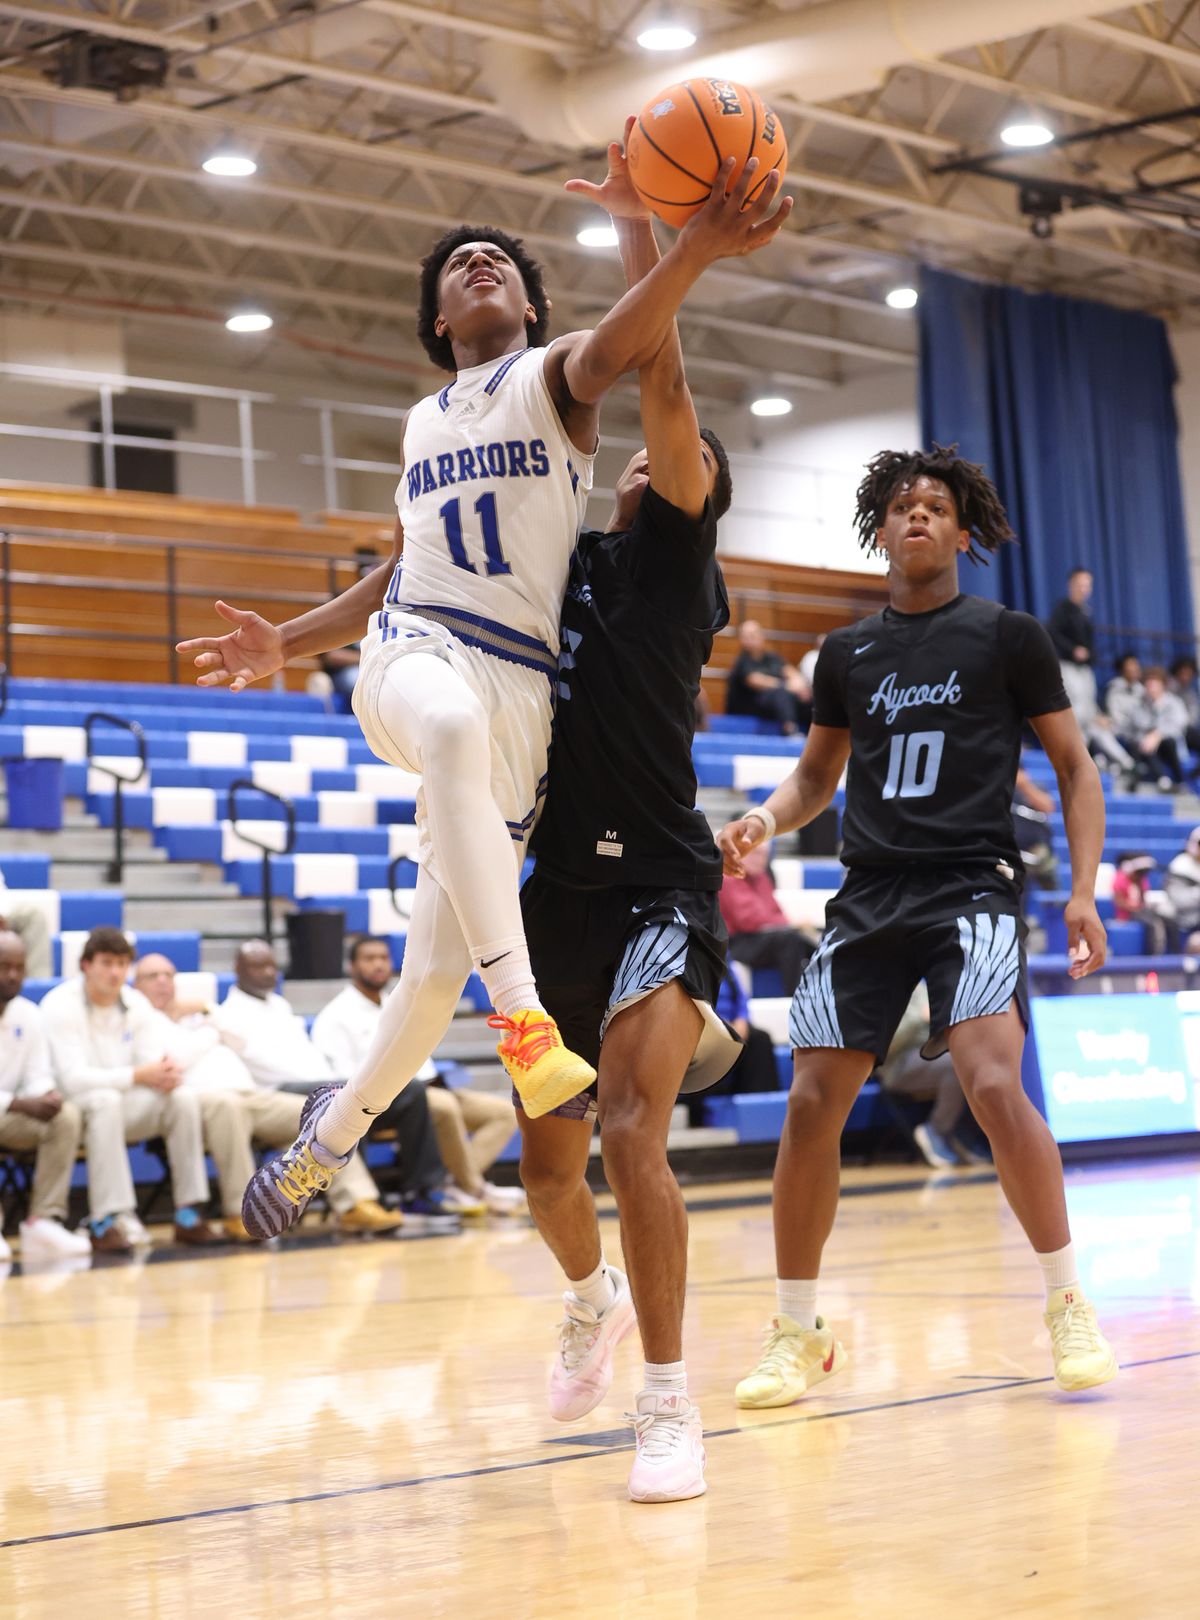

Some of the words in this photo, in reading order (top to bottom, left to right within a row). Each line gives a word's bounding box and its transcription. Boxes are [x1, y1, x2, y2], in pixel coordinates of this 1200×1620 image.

[406, 438, 551, 502] WARRIORS
[438, 490, 515, 577] 11
[866, 669, 962, 725] Aycock
[882, 730, 946, 800] 10
[605, 830, 617, 840] M
